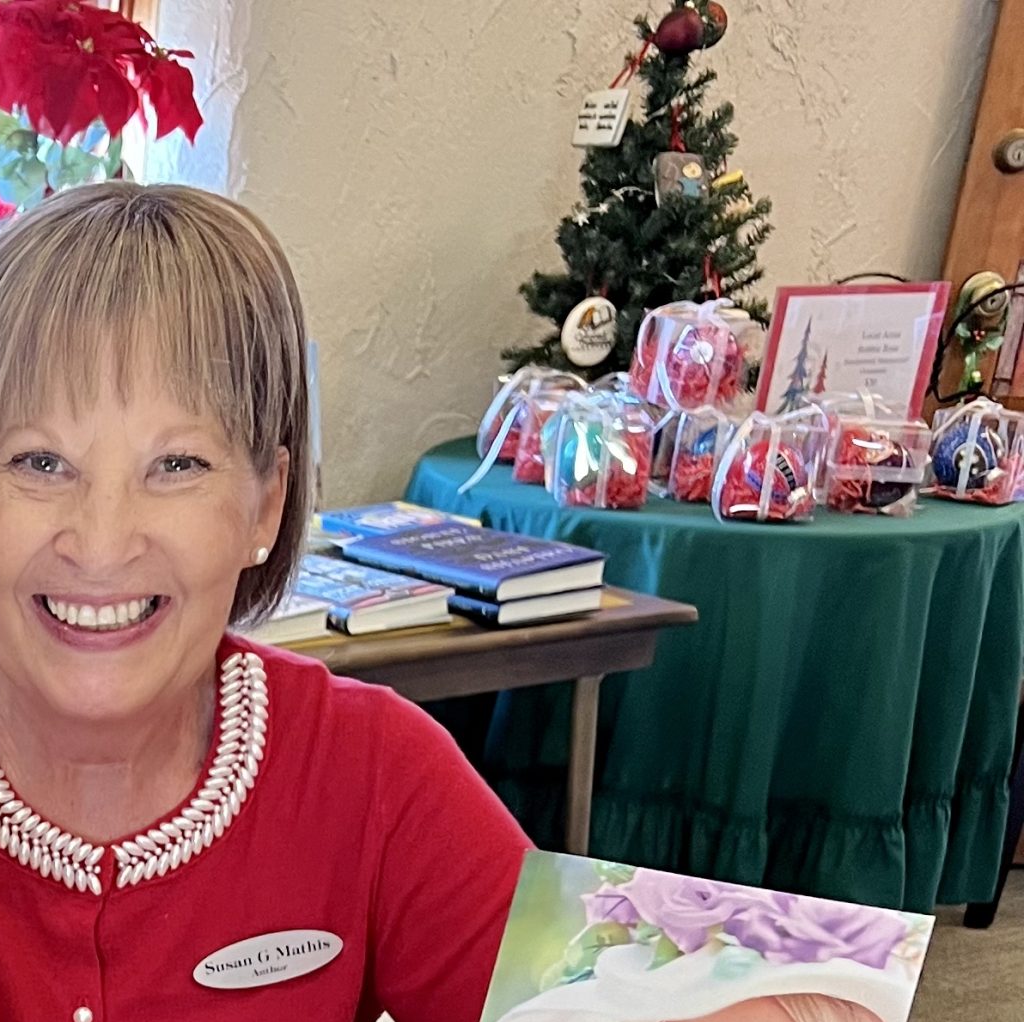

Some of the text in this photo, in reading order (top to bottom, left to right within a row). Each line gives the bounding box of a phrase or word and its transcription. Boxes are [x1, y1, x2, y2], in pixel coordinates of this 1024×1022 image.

[204, 939, 331, 975] Susan G Mathis
[252, 964, 288, 978] Author
